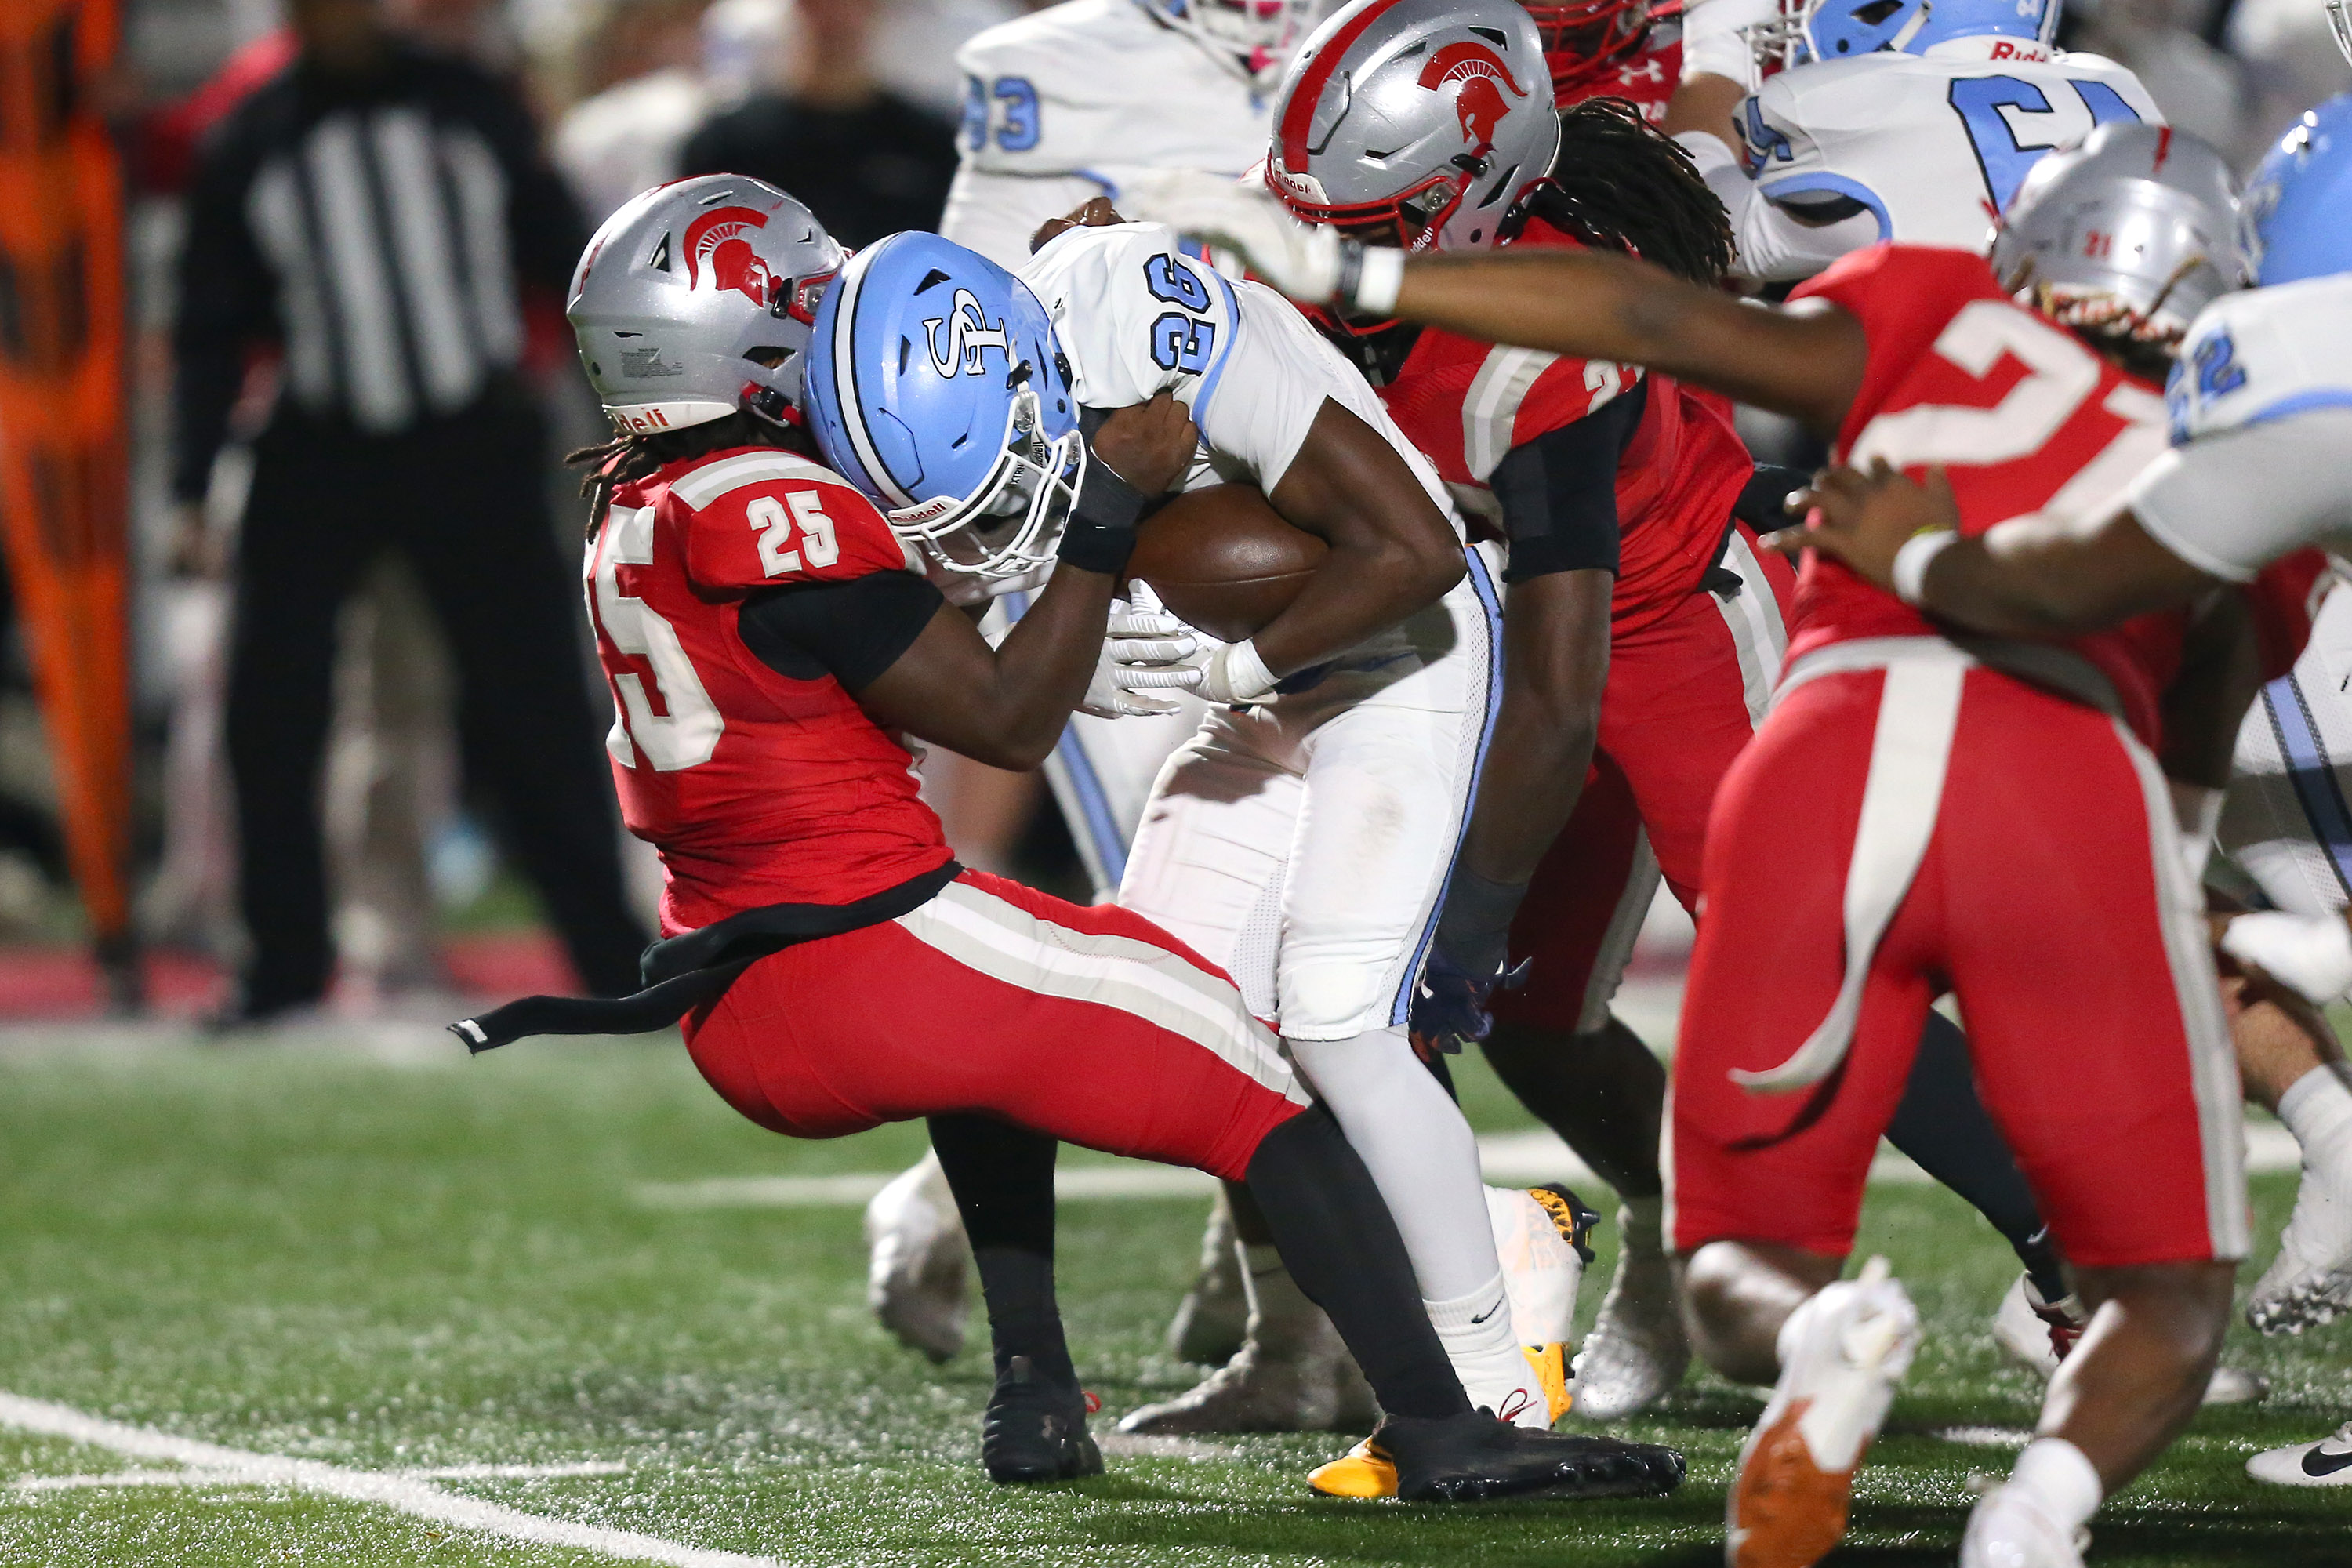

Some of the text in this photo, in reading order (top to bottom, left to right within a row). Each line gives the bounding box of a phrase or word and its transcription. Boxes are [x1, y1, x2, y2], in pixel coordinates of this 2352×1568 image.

[1142, 252, 1216, 377] 26
[1582, 359, 1646, 416] 2
[746, 490, 840, 579] 25
[583, 504, 726, 771] 5
